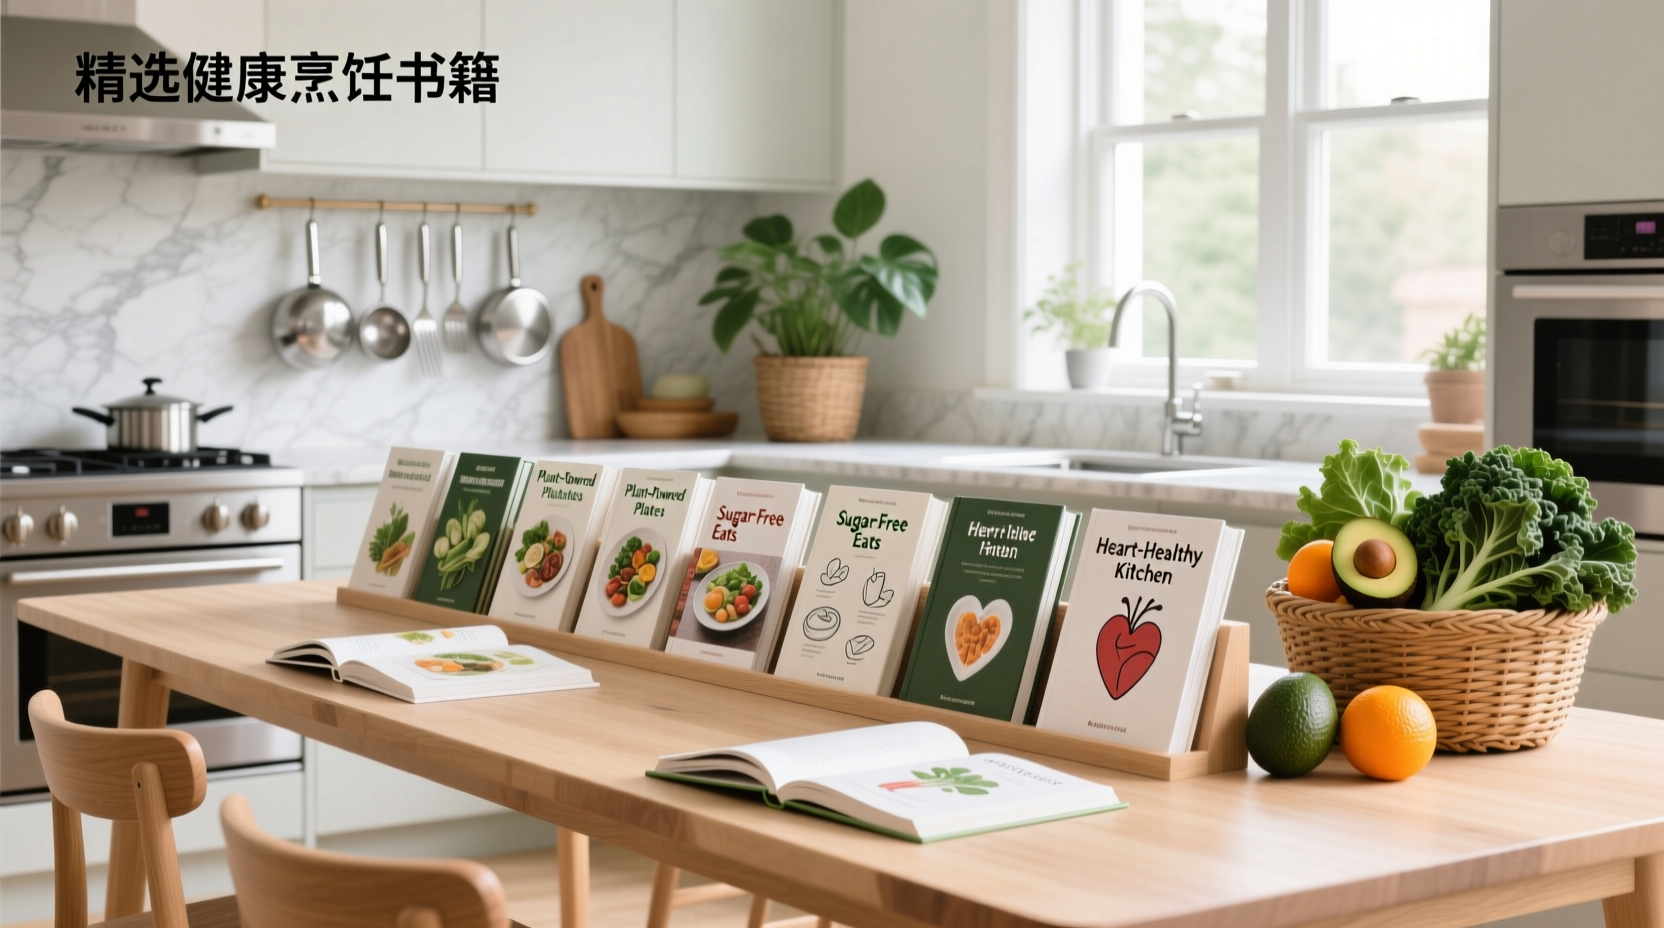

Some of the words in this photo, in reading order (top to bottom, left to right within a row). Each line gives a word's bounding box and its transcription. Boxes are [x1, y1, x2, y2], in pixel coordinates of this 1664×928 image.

[757, 509, 785, 527] Free
[836, 509, 878, 533] Sugar
[878, 513, 909, 533] Free
[711, 524, 738, 542] Eats
[852, 532, 882, 550] Eats
[1096, 537, 1203, 568] Heart-Healthy
[1114, 562, 1173, 585] Kitchen
